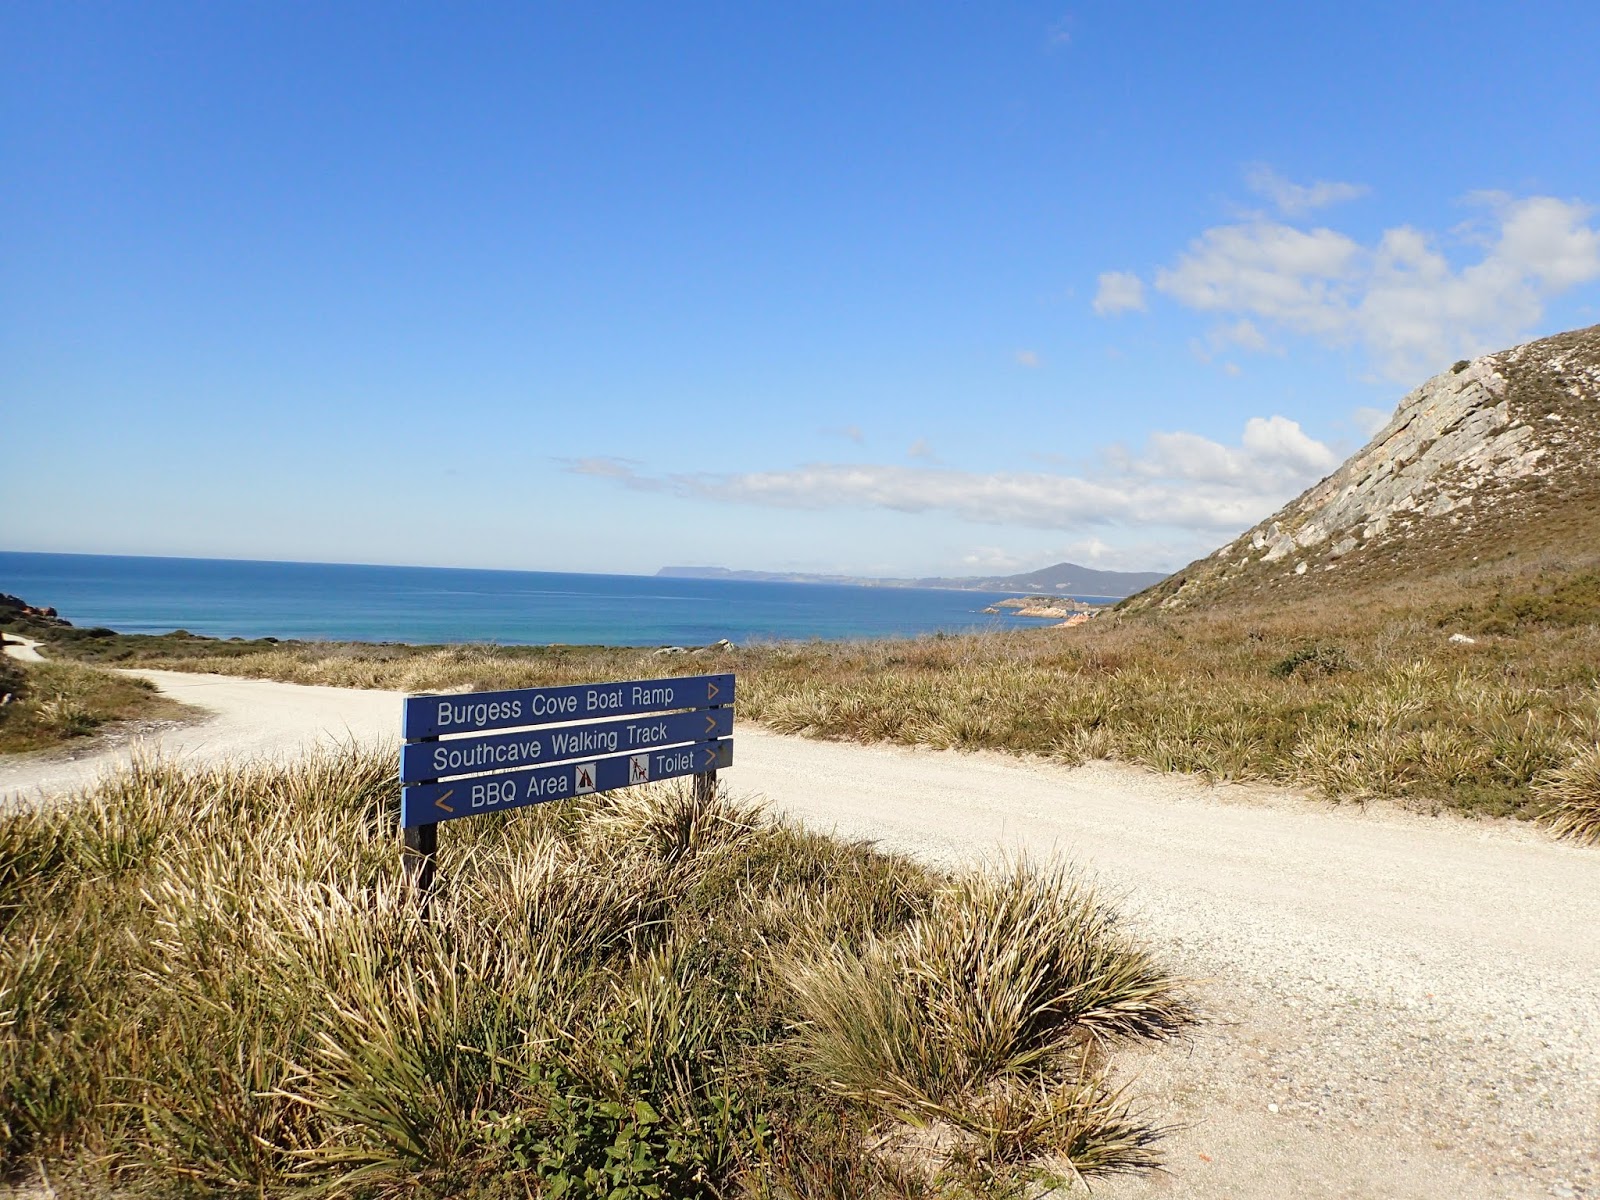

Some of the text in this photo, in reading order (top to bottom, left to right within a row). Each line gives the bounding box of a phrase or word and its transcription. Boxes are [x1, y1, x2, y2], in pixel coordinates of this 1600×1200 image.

[437, 686, 674, 728] Burgess Cove Boat Ramp
[433, 722, 668, 771] Southcave Walking Track
[656, 752, 694, 774] Toilet
[471, 773, 568, 808] BBQ Area
